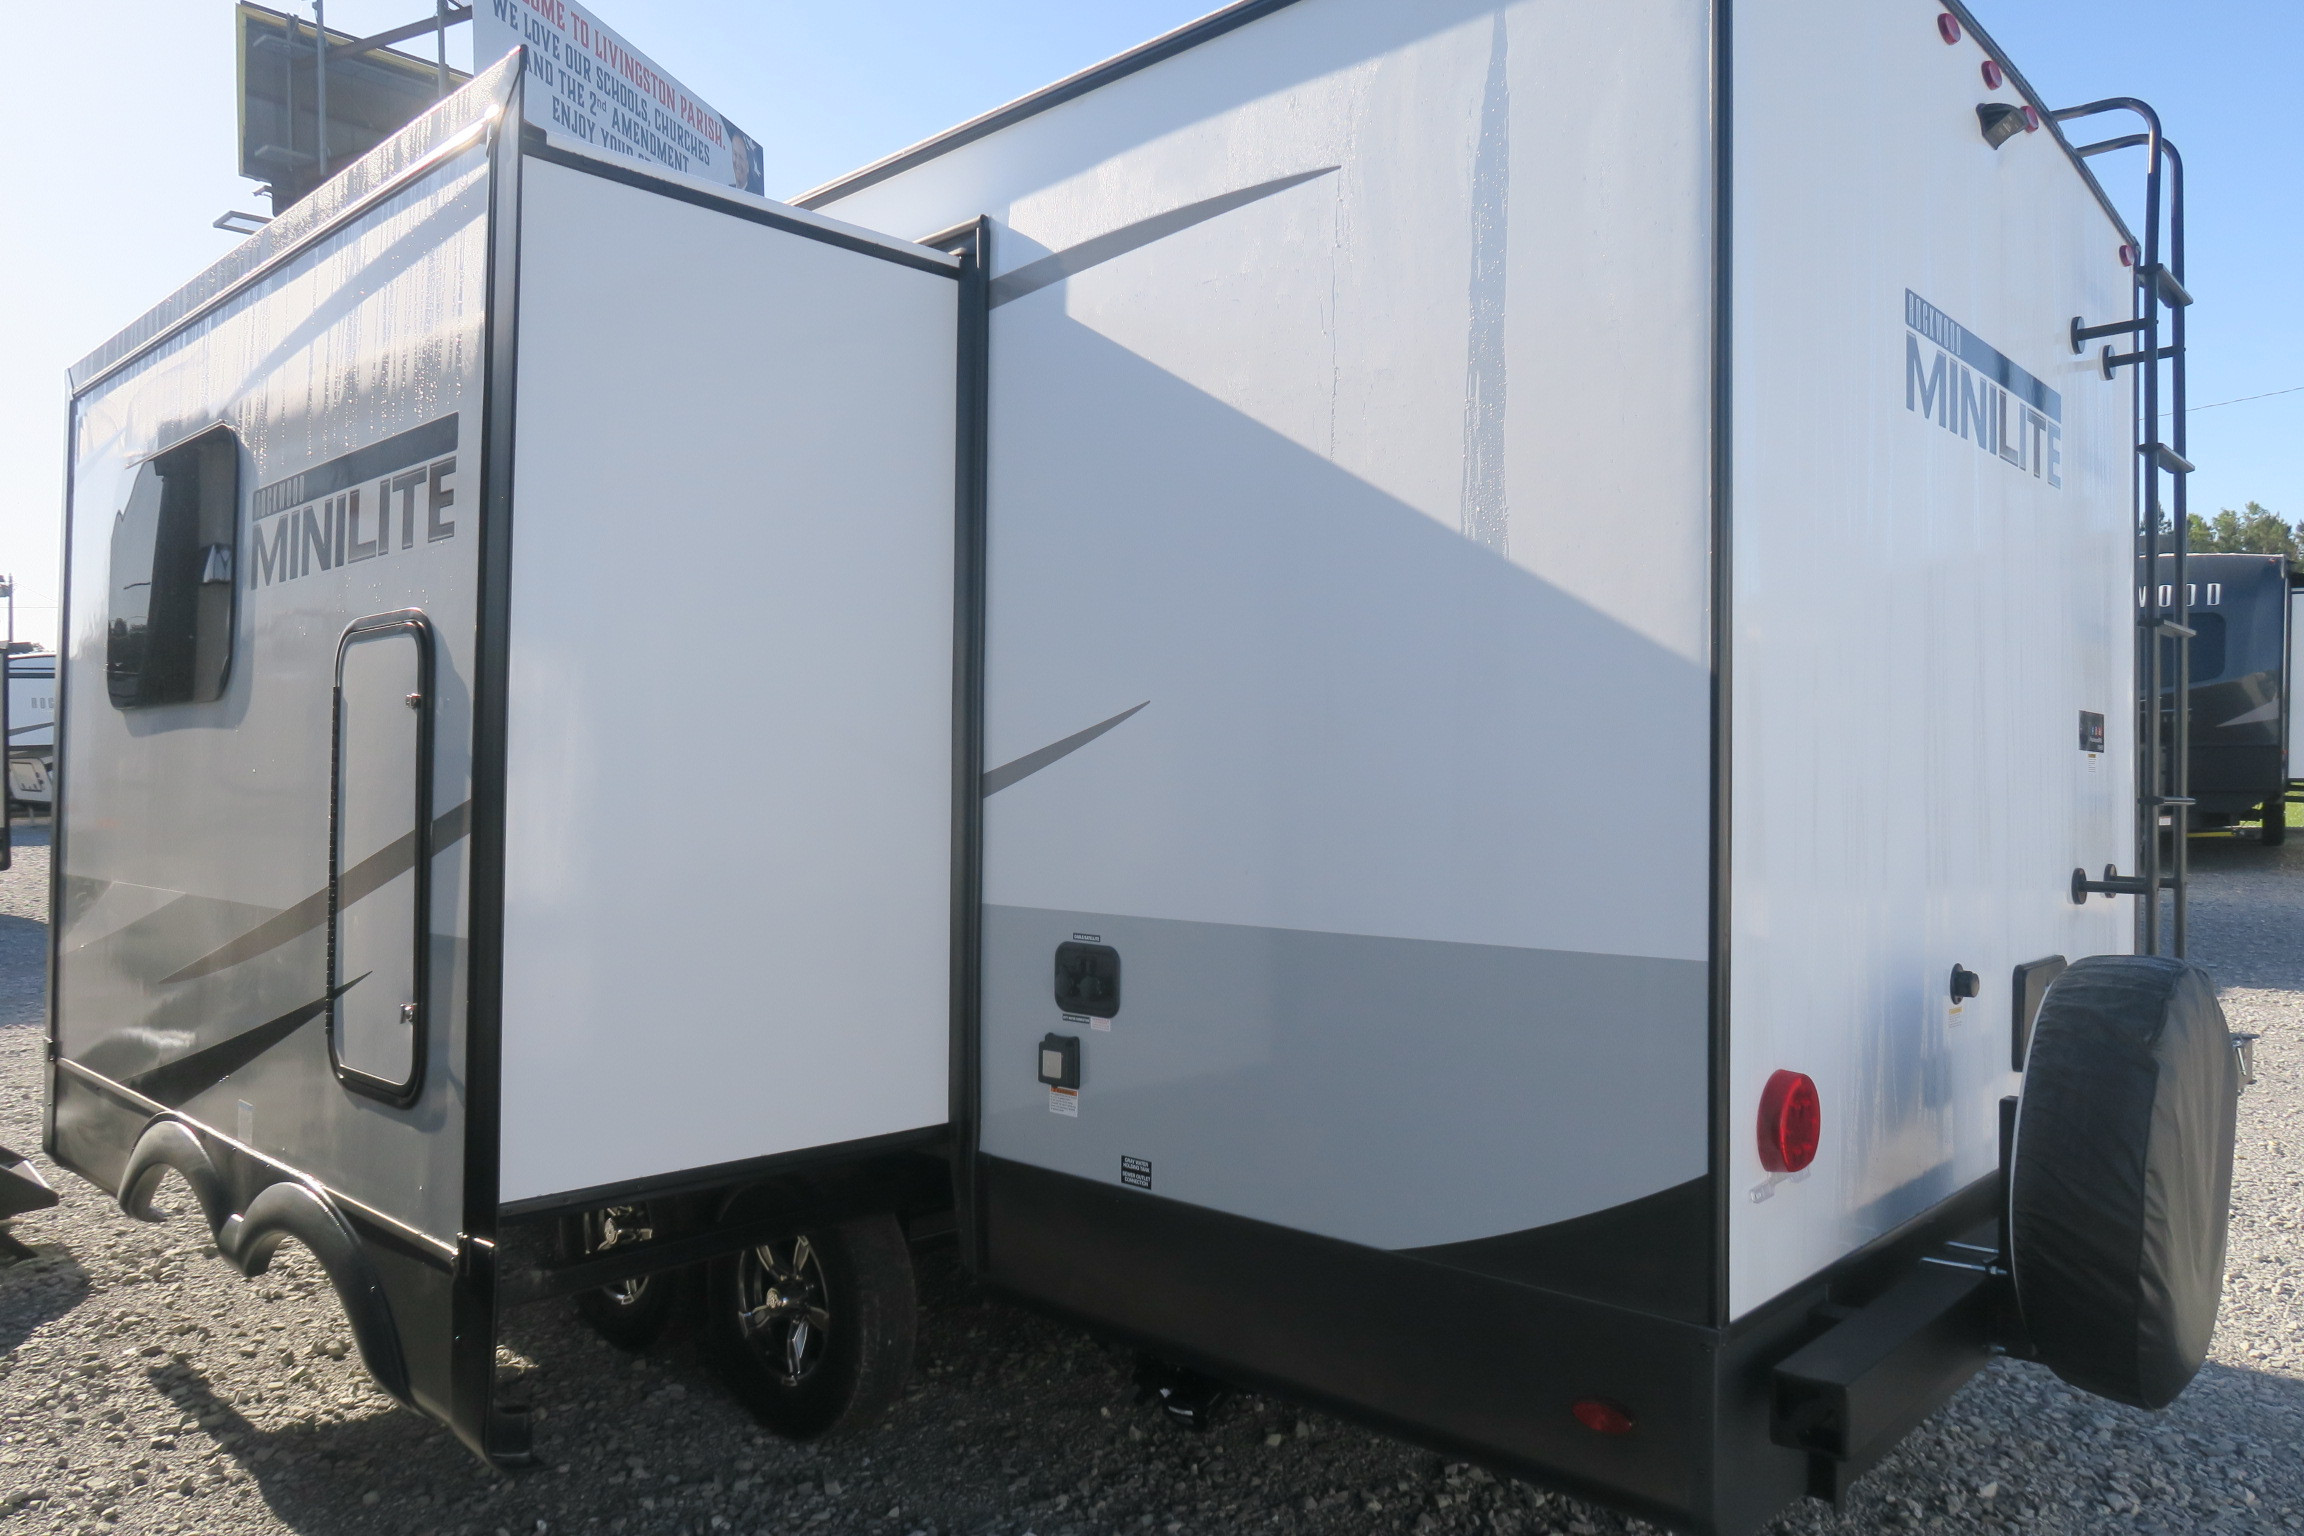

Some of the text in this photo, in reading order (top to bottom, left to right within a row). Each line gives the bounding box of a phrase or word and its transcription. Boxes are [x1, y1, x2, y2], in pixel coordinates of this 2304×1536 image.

[493, 0, 710, 166] WE LOVE OUR SCHOOLS, CHURCHES
[523, 0, 726, 149] ME TO LIVINGSTON PARISH.
[552, 95, 596, 144] ENJOY
[558, 68, 585, 108] THE
[612, 107, 690, 173] AMENDMENT
[1908, 293, 1961, 356] ROCKWOOD
[1906, 330, 2061, 490] MINILITE
[250, 455, 457, 590] MINILITE
